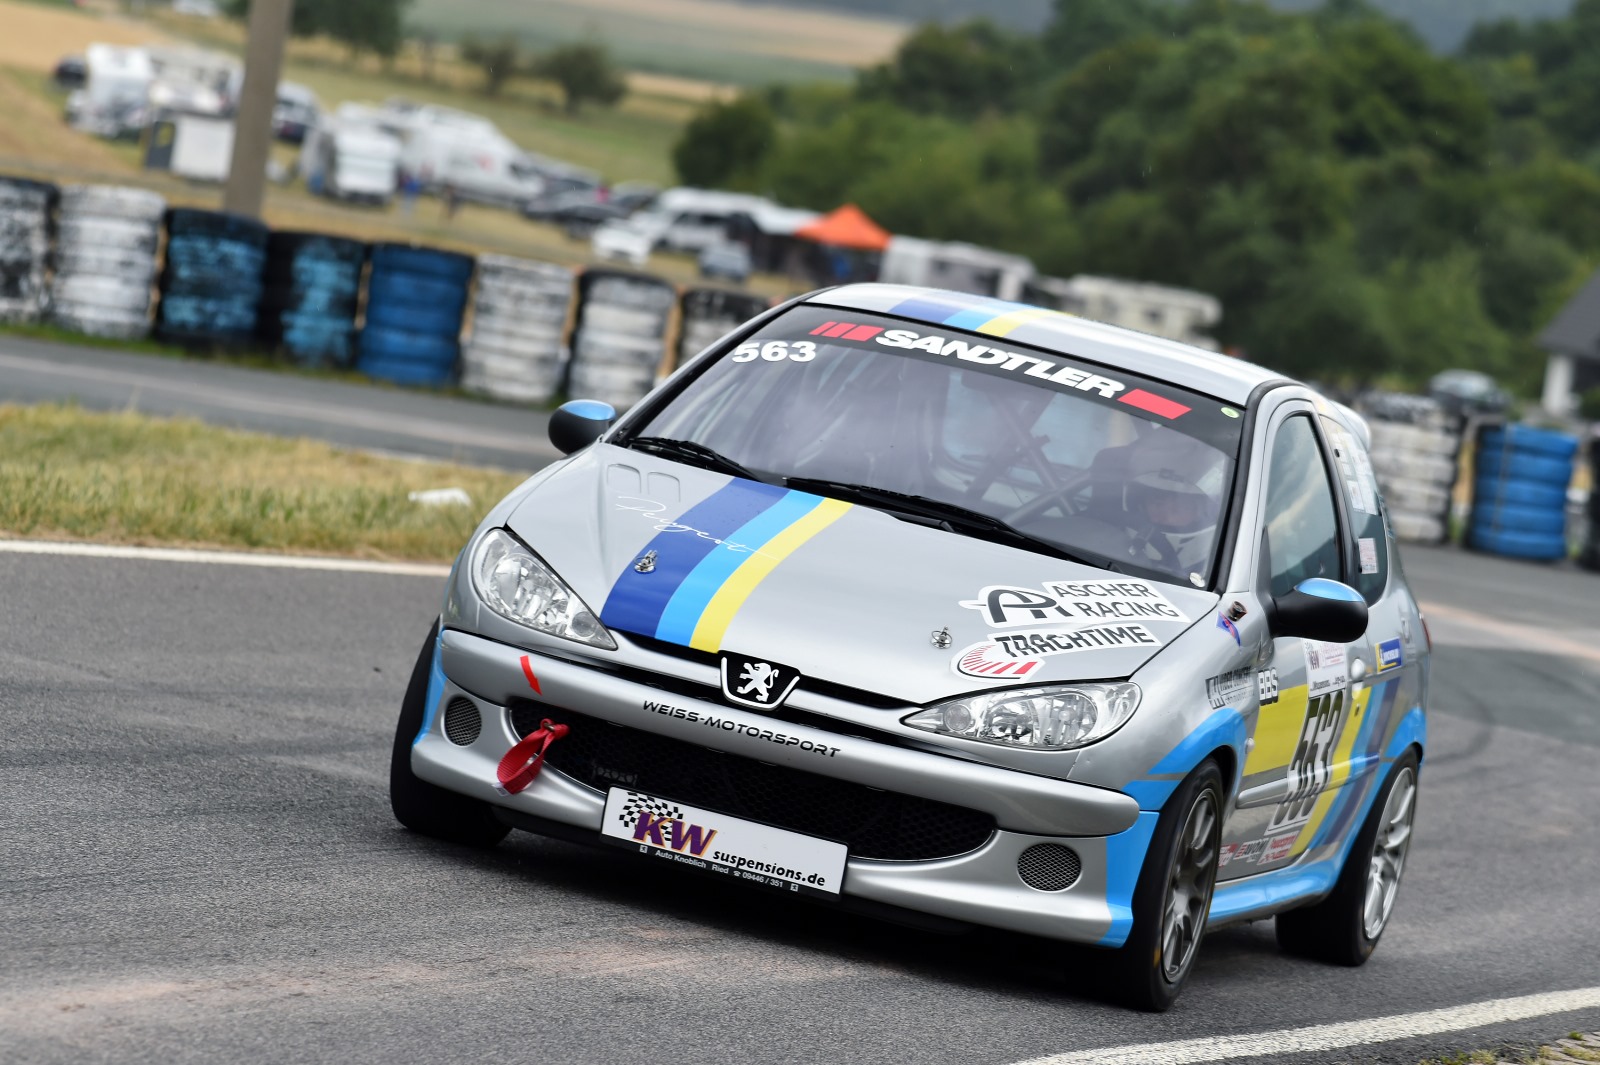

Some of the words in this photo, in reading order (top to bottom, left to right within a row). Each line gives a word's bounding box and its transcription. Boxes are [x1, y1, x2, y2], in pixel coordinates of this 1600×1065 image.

[731, 341, 817, 364] 563
[874, 329, 1127, 398] SANDTLER
[1051, 582, 1158, 599] ASCHER
[1072, 600, 1180, 619] RACING
[642, 700, 841, 758] WEISS-MOTORSPORT
[1273, 690, 1344, 826] 563
[632, 810, 718, 858] KW
[655, 850, 673, 861] Auto
[674, 854, 707, 869] Knoblich
[711, 864, 729, 875] Ried
[770, 879, 784, 888] 351
[712, 849, 826, 888] suspensions.de
